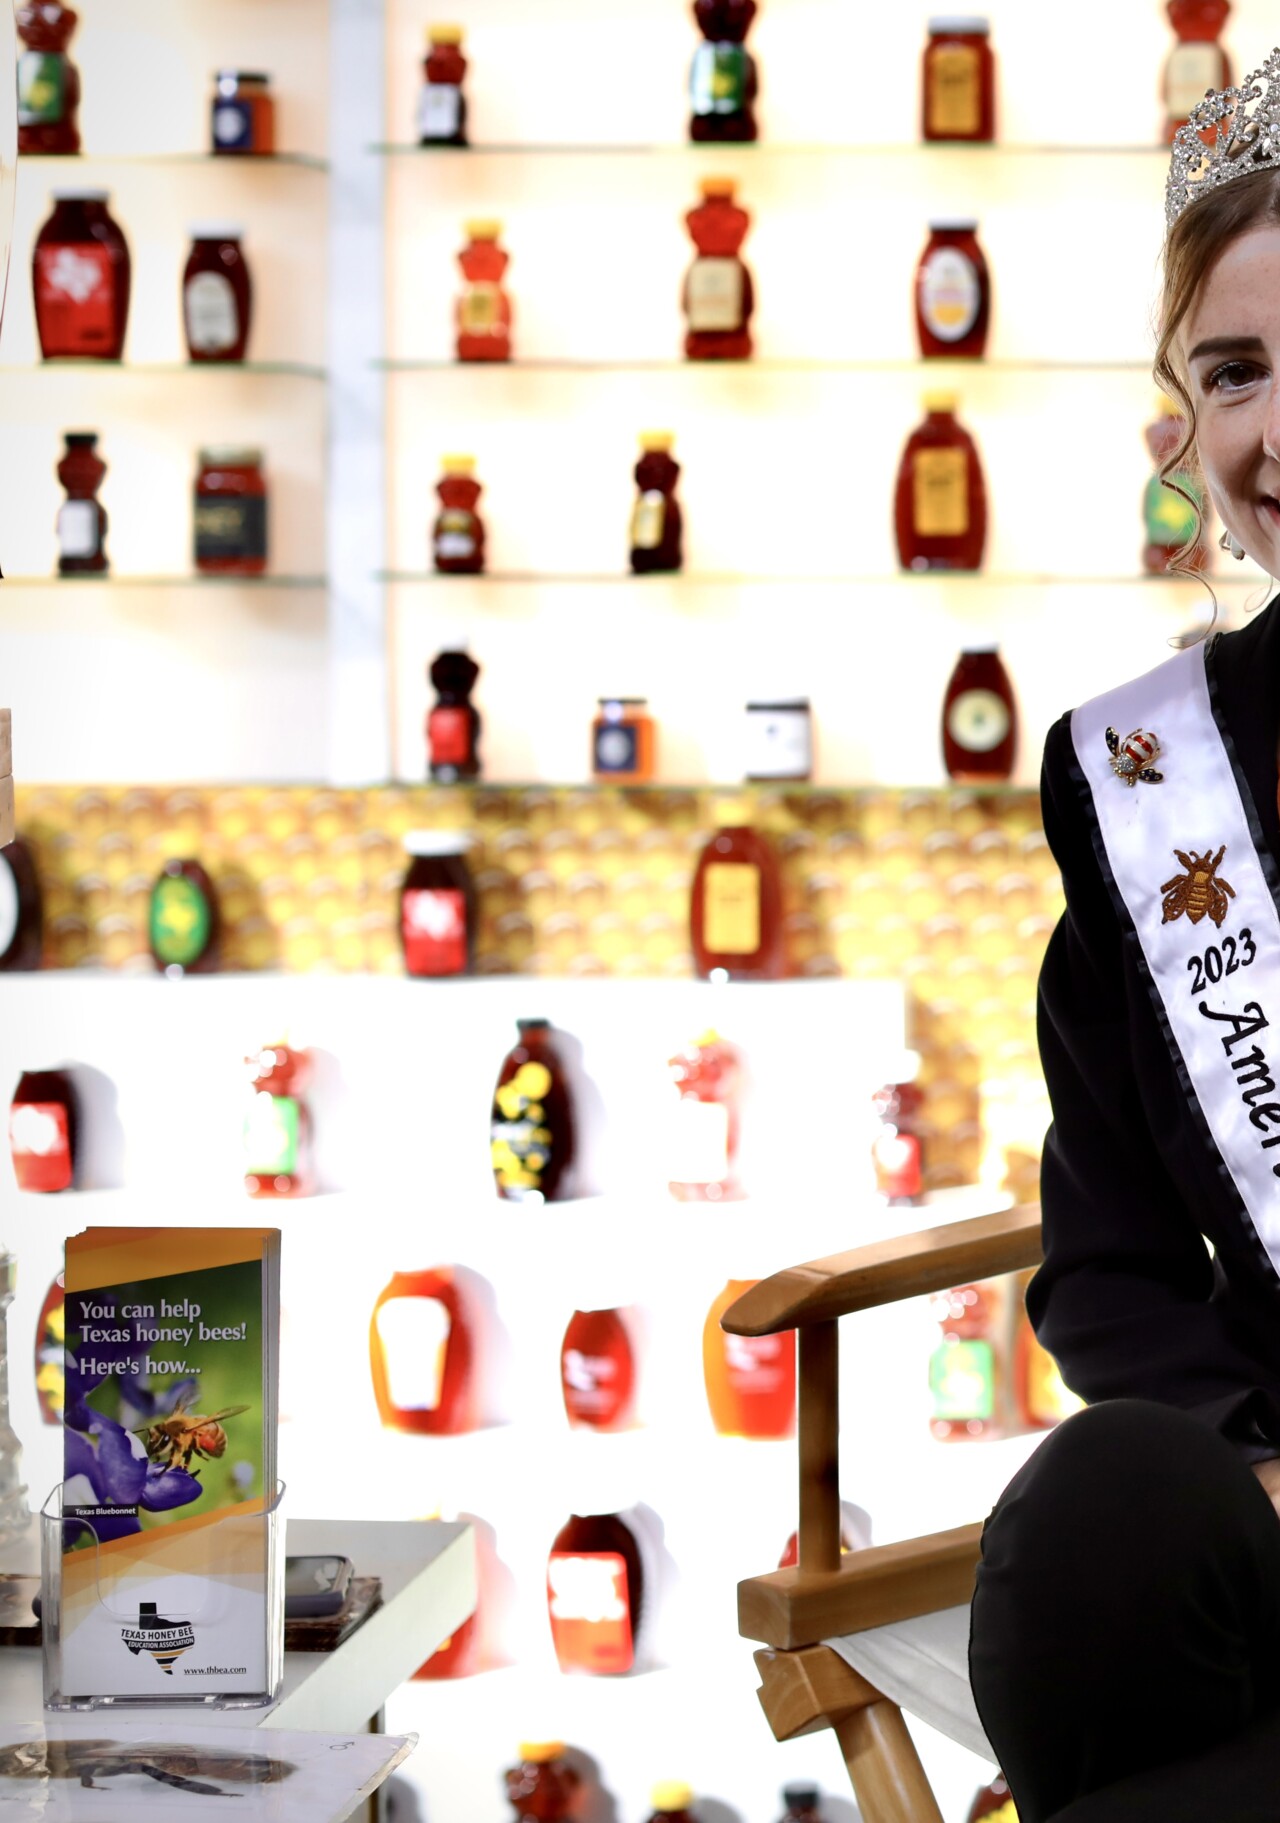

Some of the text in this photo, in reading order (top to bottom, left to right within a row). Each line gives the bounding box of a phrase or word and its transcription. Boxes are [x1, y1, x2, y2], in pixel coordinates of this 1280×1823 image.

[1187, 928, 1257, 995] 2023
[80, 1299, 201, 1323] You can help
[79, 1322, 247, 1346] Texas honey bees!
[80, 1355, 201, 1375] Here's how...
[95, 1507, 136, 1515] Bluebonnet
[121, 1626, 194, 1640] TEXAS HONEY BEE
[127, 1637, 194, 1649] EDUCATION ASSOCIATION
[184, 1665, 247, 1676] www.thbea.com
